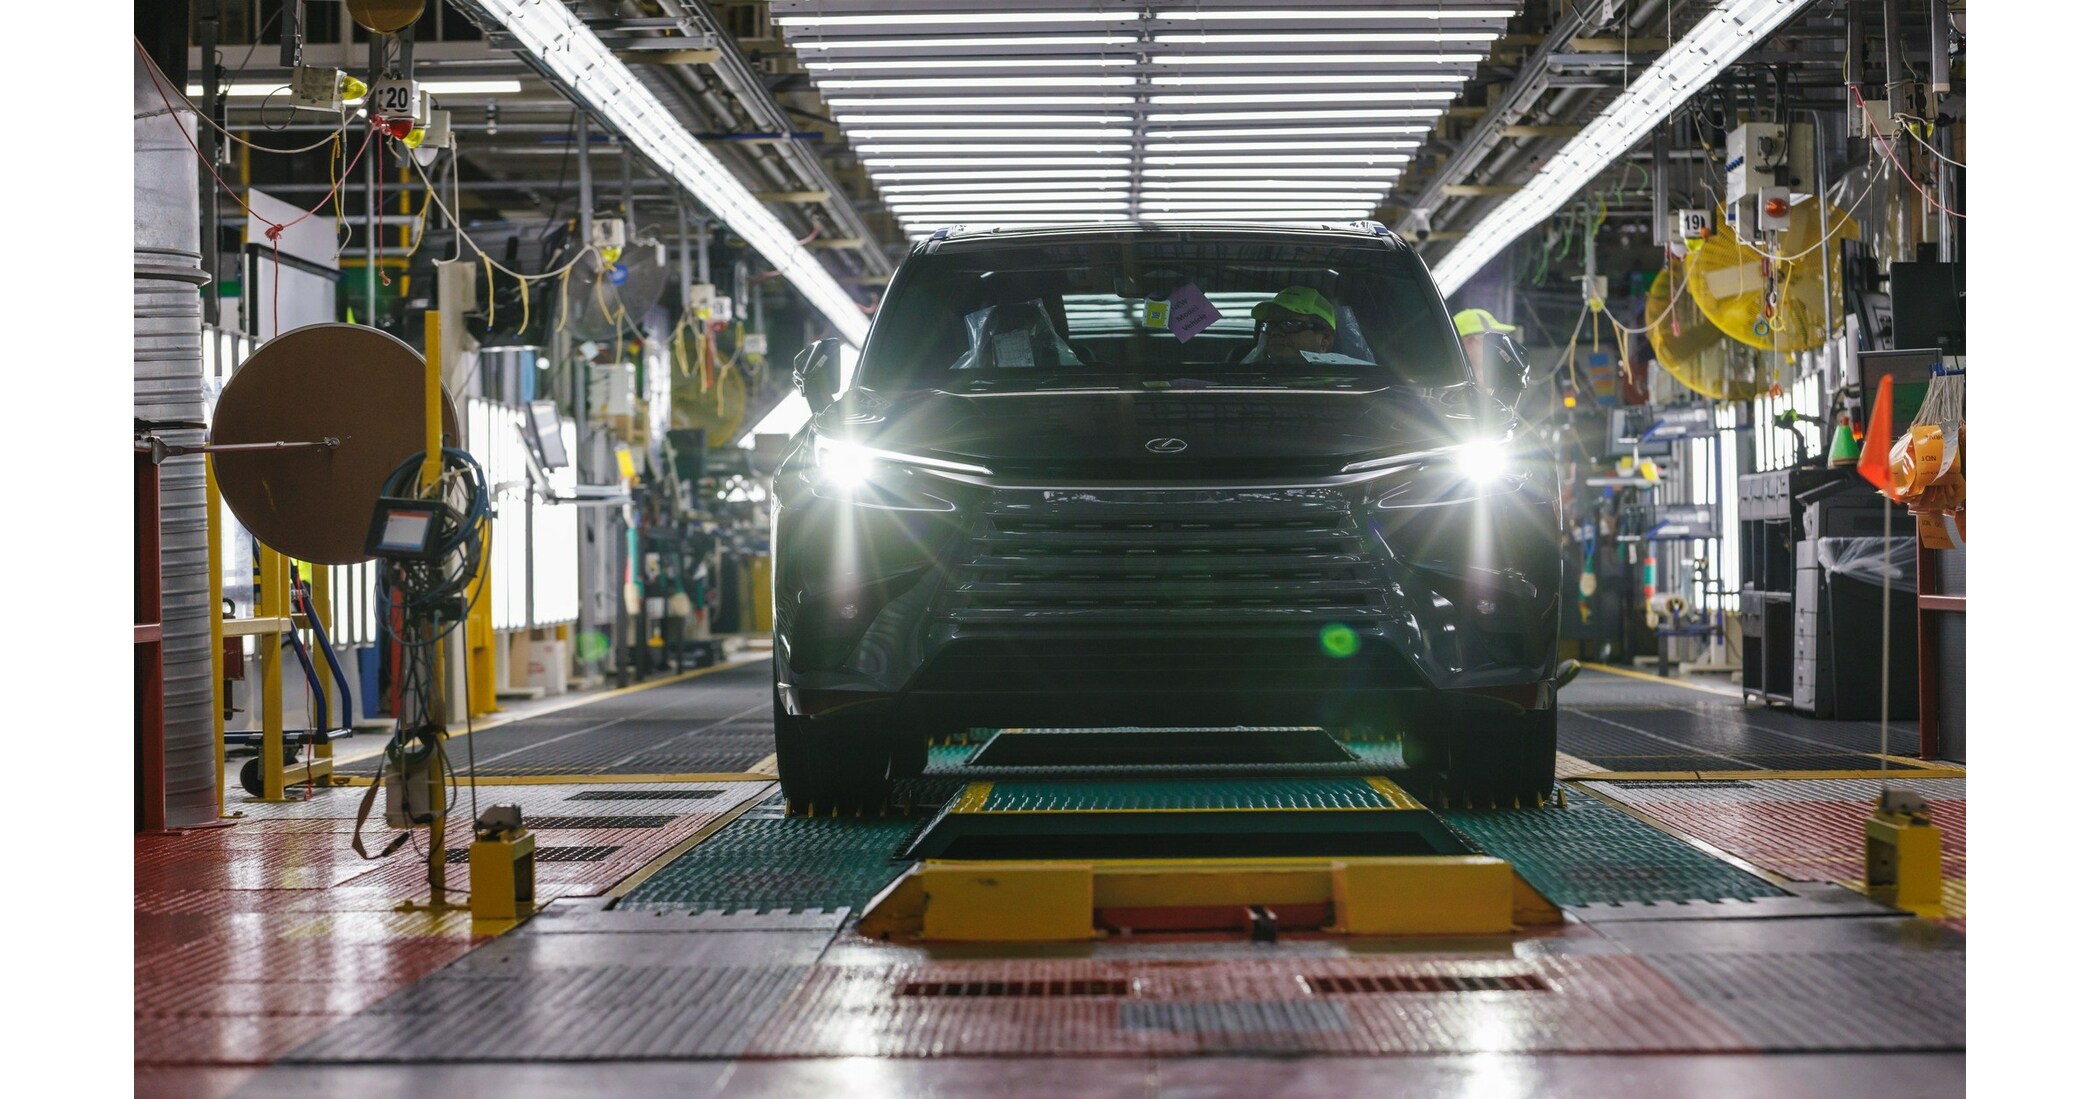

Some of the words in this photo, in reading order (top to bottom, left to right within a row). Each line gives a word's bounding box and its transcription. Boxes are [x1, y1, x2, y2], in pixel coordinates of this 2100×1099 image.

[386, 87, 408, 108] 20
[1684, 214, 1700, 230] 19
[1176, 305, 1199, 322] Model
[1182, 313, 1207, 331] Vehicle
